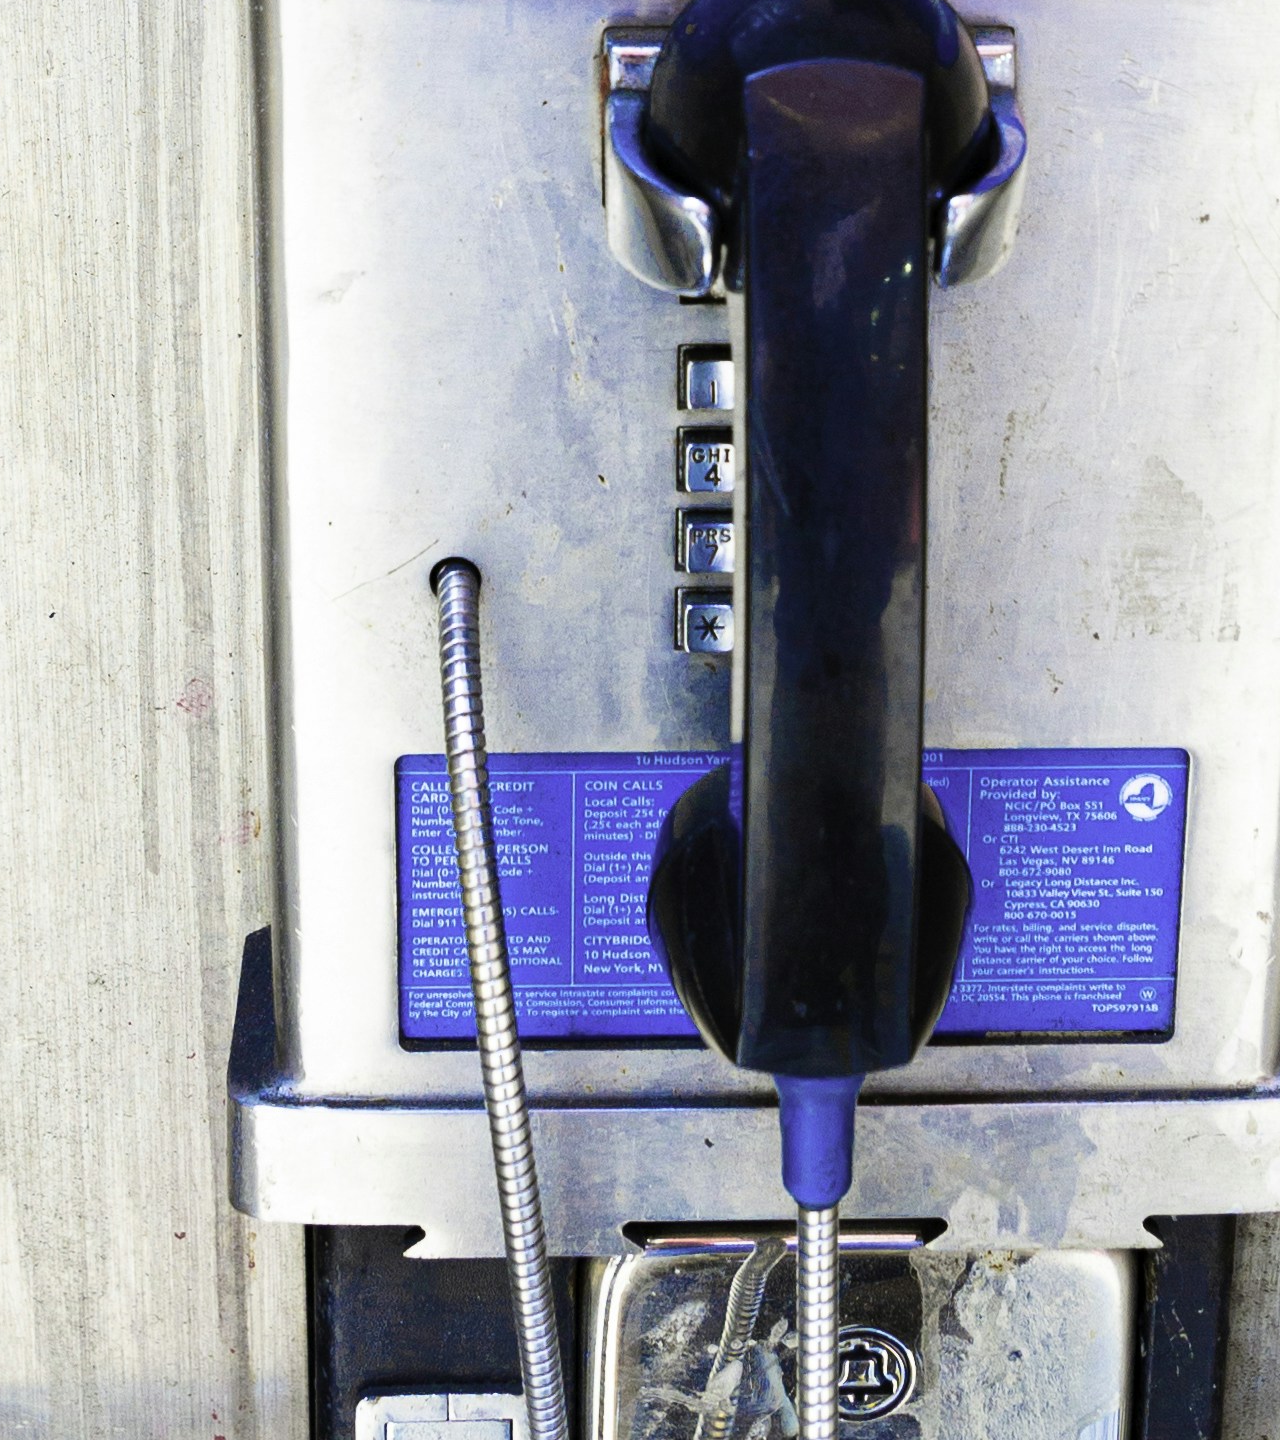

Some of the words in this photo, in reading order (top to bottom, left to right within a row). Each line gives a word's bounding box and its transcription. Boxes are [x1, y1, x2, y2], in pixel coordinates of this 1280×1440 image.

[691, 448, 731, 464] GHI
[704, 463, 721, 488] 4
[691, 528, 732, 544] PRS
[705, 544, 719, 566] 7
[654, 755, 703, 765] Hudson
[489, 782, 535, 792] CREDIT
[585, 781, 618, 791] COIN
[623, 781, 663, 791] CALLS
[980, 777, 1038, 789] Operator
[1044, 776, 1110, 788] Assistance
[412, 793, 449, 803] CARD
[980, 790, 1037, 800] Provided
[1042, 789, 1061, 802] by:
[585, 798, 617, 807] Local
[622, 797, 655, 807] Calls:
[1060, 801, 1081, 811] Box
[412, 806, 434, 815] Dial
[494, 806, 523, 814] Code
[584, 809, 627, 820] Deposit
[493, 817, 512, 826] for
[514, 817, 544, 827] Tone,
[1004, 812, 1062, 824] Longview,
[1066, 812, 1080, 822] TX
[616, 820, 641, 829] each
[412, 829, 441, 837] Enter
[584, 831, 634, 842] minutes)
[496, 844, 549, 854] PERSON
[1031, 845, 1058, 855] West
[1062, 844, 1099, 854] Desert
[1103, 844, 1121, 854] Inn
[1124, 844, 1153, 853] Road
[584, 852, 627, 861] Outside
[631, 852, 652, 861] this
[412, 857, 429, 867] TO
[999, 857, 1017, 866] Las
[1021, 856, 1058, 868] Vegas,
[1062, 856, 1078, 865] NV
[1005, 878, 1042, 890] Legacy
[1044, 877, 1071, 889] Long
[1073, 877, 1119, 887] Distance
[584, 894, 615, 907] Long
[1004, 900, 1047, 912] Cypress,
[1050, 899, 1065, 908] CA
[412, 919, 434, 928] Dial
[527, 935, 551, 945] AND
[413, 948, 450, 957] CREDIT
[523, 946, 547, 955] MAY
[603, 950, 651, 960] Hudson
[584, 965, 611, 974] New
[614, 963, 645, 975] York,
